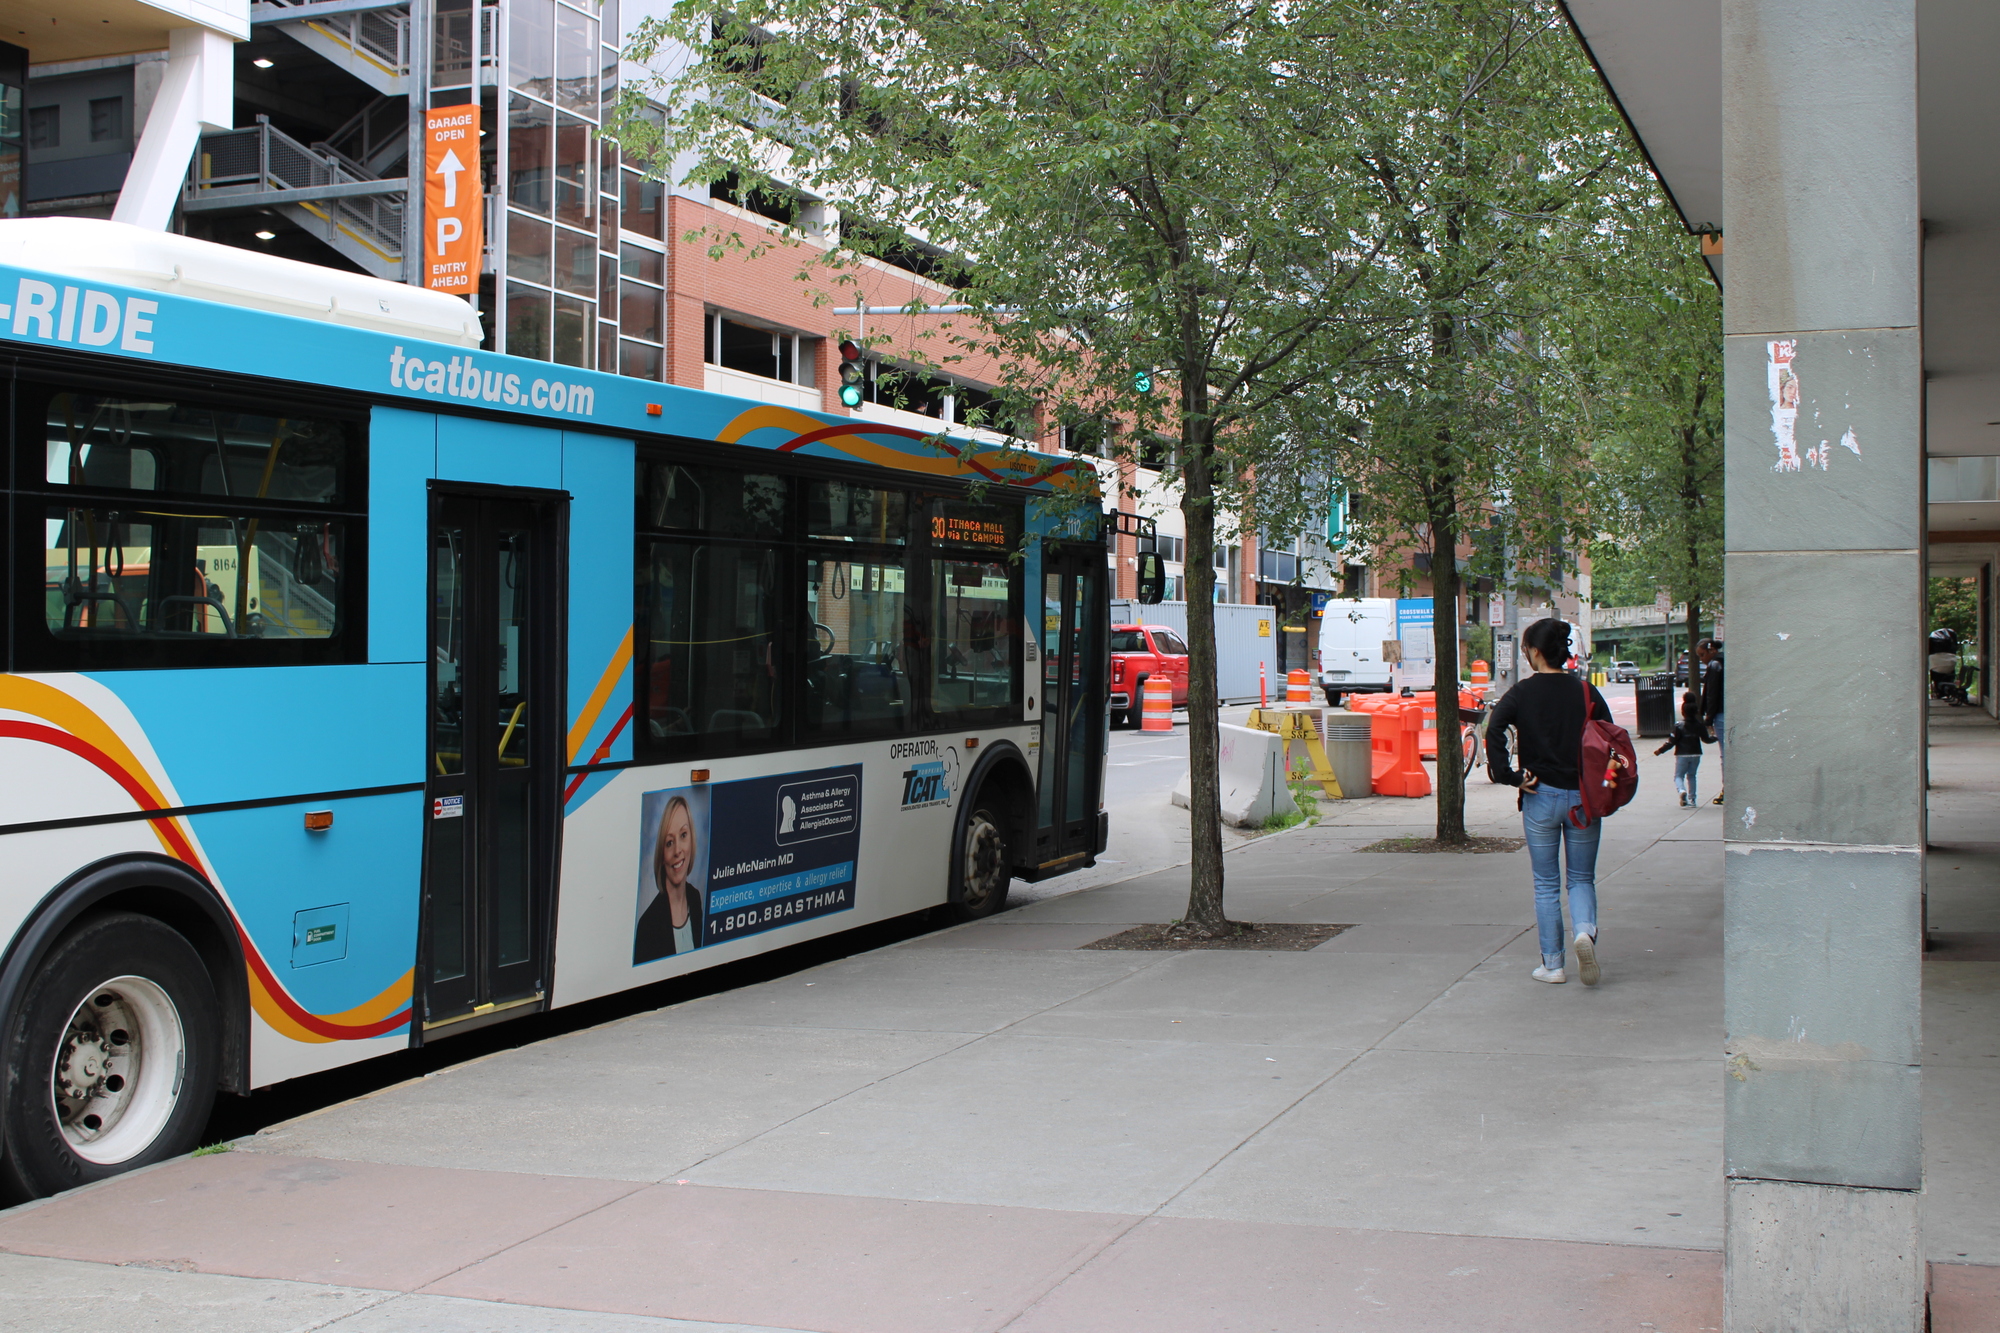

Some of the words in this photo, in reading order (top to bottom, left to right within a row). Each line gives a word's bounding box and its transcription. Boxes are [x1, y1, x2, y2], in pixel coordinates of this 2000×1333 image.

[428, 115, 472, 129] GARAGE
[435, 129, 465, 142] OPEN
[437, 217, 462, 256] P
[432, 262, 467, 274] ENTRY
[431, 275, 468, 288] AHEAD
[390, 346, 595, 416] tcatbus.com
[1010, 462, 1027, 474] USDOT
[931, 517, 946, 539] 30
[949, 519, 981, 531] ITHACA
[983, 522, 1004, 534] MALL
[1066, 518, 1081, 535] 1112
[948, 531, 960, 540] via
[963, 531, 969, 541] C
[972, 532, 1005, 544] CAMPUS
[214, 558, 237, 571] 8164
[1317, 595, 1325, 605] P
[1291, 731, 1309, 739] S&F
[890, 740, 936, 759] OPERATOR
[918, 767, 943, 775] TOMPKINS
[1292, 772, 1306, 780] S&
[801, 792, 825, 801] Asthma
[825, 789, 830, 797] &
[831, 788, 851, 797] Allergy
[902, 770, 941, 805] TCAT
[444, 798, 460, 806] NOTICE
[801, 802, 833, 814] Associates
[834, 800, 845, 808] P.C.
[800, 815, 852, 830] AllergistDocs.com
[713, 866, 735, 880] Julie
[736, 858, 776, 875] McNairn
[778, 853, 794, 866] MD
[711, 890, 755, 909] Experience,
[759, 880, 792, 898] expertise
[795, 876, 801, 888] &
[804, 873, 827, 886] allergy
[829, 865, 847, 880] relief
[710, 889, 845, 935] 1.800.88ASTHMA
